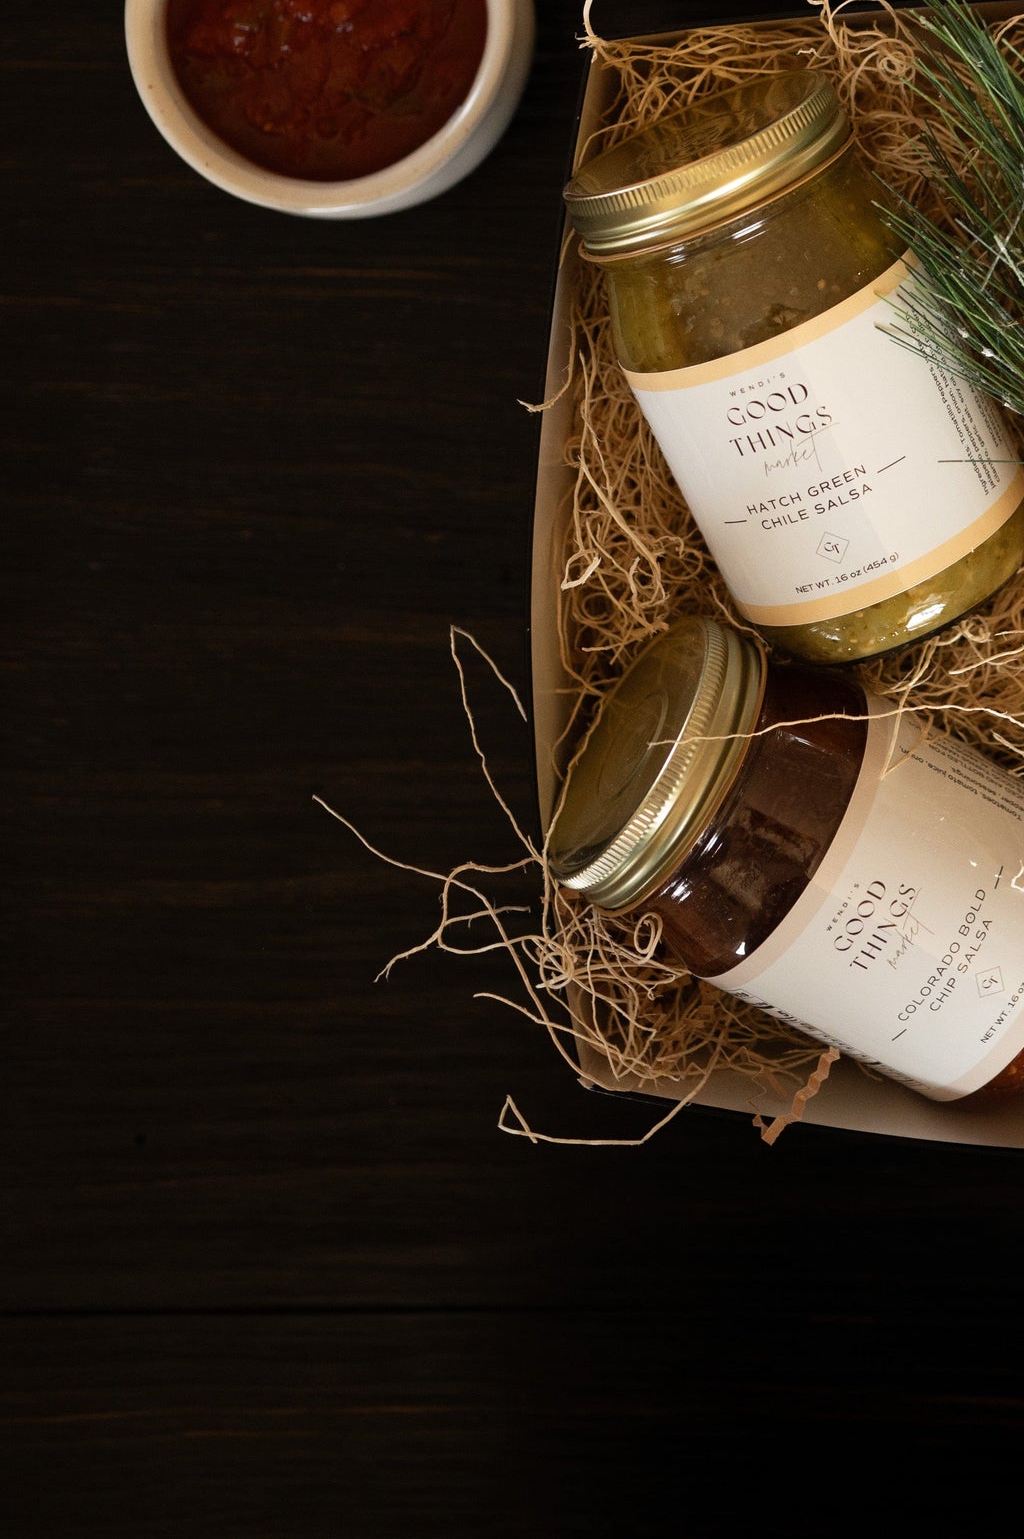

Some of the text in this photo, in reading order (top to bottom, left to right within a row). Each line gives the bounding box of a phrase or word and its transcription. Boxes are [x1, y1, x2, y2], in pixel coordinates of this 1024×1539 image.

[727, 383, 808, 426] GOOD
[729, 372, 786, 397] WENDI'S
[928, 364, 948, 402] Peppers,
[946, 387, 962, 413] onion,
[729, 406, 833, 456] THINGS
[945, 404, 966, 444] Tomatillo
[959, 413, 981, 452] peppers,
[764, 421, 840, 477] market
[746, 464, 868, 515] HATCH GREEN
[761, 483, 874, 530] CHILE SALSA
[795, 552, 900, 595] NET WT. 16 oz (454 g)
[897, 745, 924, 764] onin,
[922, 759, 947, 777] juice,
[946, 773, 979, 795] tomato
[826, 883, 860, 932] WENDI'S
[834, 881, 886, 951] GOOD
[849, 884, 916, 970] THINGS
[887, 887, 935, 970] market
[897, 889, 986, 1022] COLORADO BOLD
[929, 919, 993, 1012] CHIP SALSA
[980, 1026, 997, 1044] NET
[994, 1010, 1012, 1025] WT.
[1007, 995, 1020, 1008] 16
